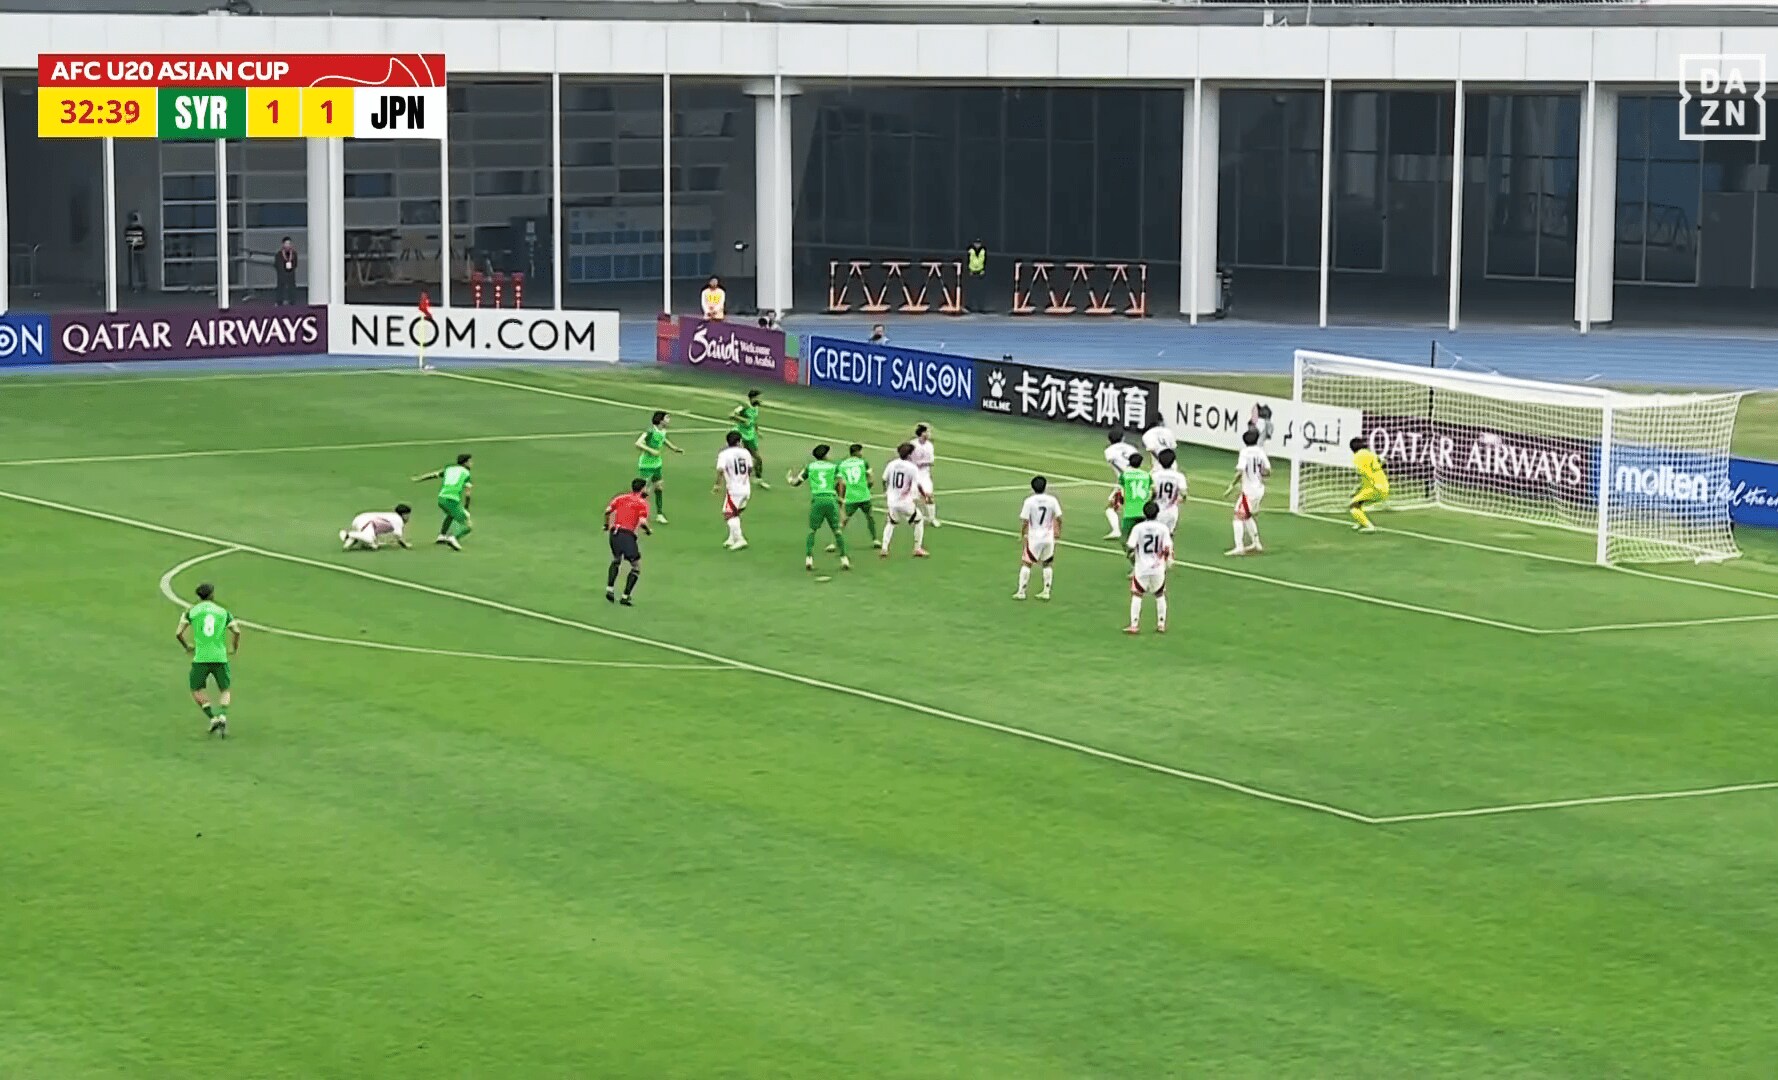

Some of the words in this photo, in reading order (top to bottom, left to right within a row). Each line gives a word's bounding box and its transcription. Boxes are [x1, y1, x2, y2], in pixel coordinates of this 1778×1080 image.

[62, 320, 171, 354] QATAR
[186, 316, 318, 348] AIRWAYS
[352, 314, 595, 351] NEOM.COM
[813, 346, 888, 387] CREDIT
[890, 357, 972, 400] SAISON
[1014, 369, 1149, 429] 卡尔美体育
[1176, 401, 1239, 433] NEOM
[1369, 427, 1454, 468] QATAR
[1467, 440, 1581, 485] AIRWAYS
[892, 472, 905, 489] 10
[1159, 482, 1174, 499] 19
[1615, 465, 1708, 501] molten
[1038, 506, 1047, 525] 7
[1143, 534, 1159, 554] 21
